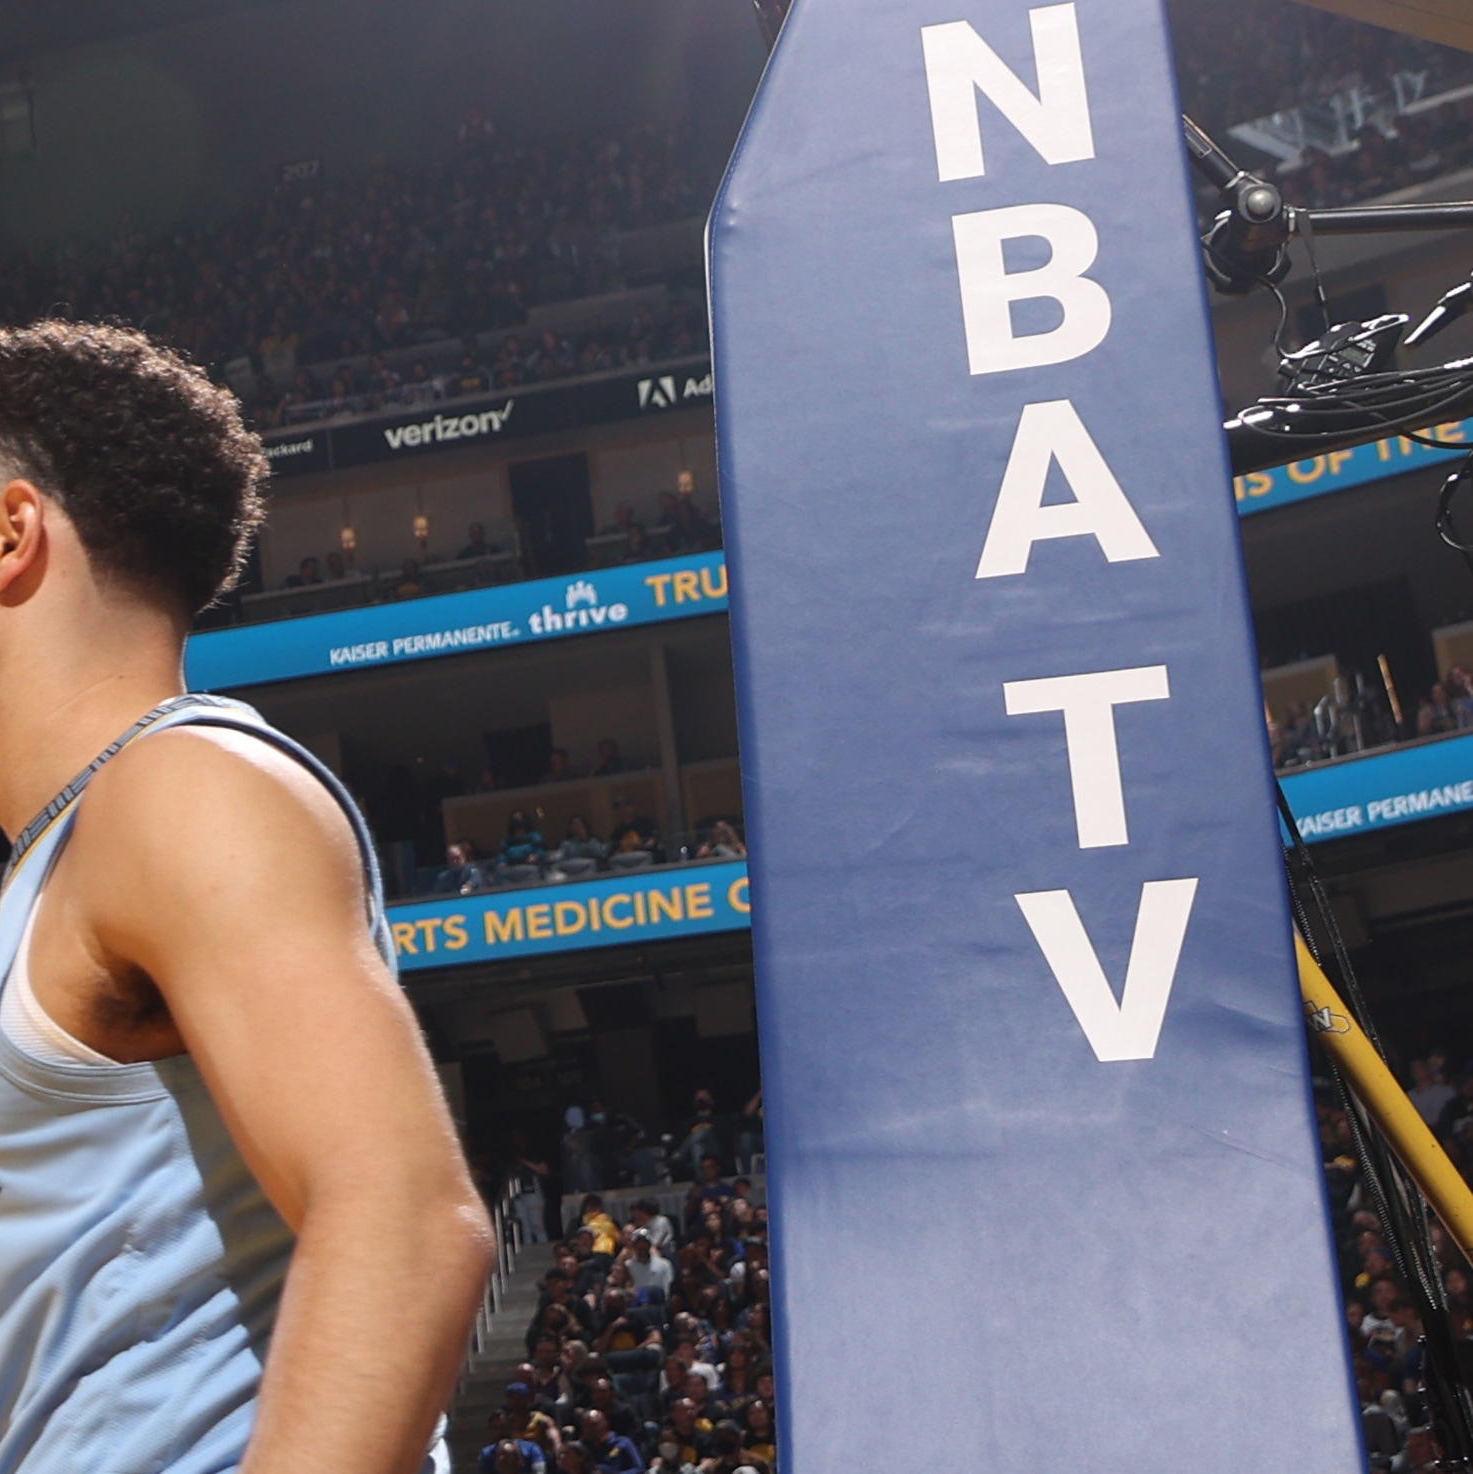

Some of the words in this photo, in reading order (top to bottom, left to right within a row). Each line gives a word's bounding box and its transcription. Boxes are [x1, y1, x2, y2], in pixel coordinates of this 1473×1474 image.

[920, 6, 1162, 580] NBA
[384, 405, 502, 450] verizon
[329, 639, 388, 666] KAISER
[529, 601, 629, 635] thrive
[1003, 663, 1199, 1063] TV
[395, 914, 470, 957] RTS
[483, 882, 715, 946] MEDICINE
